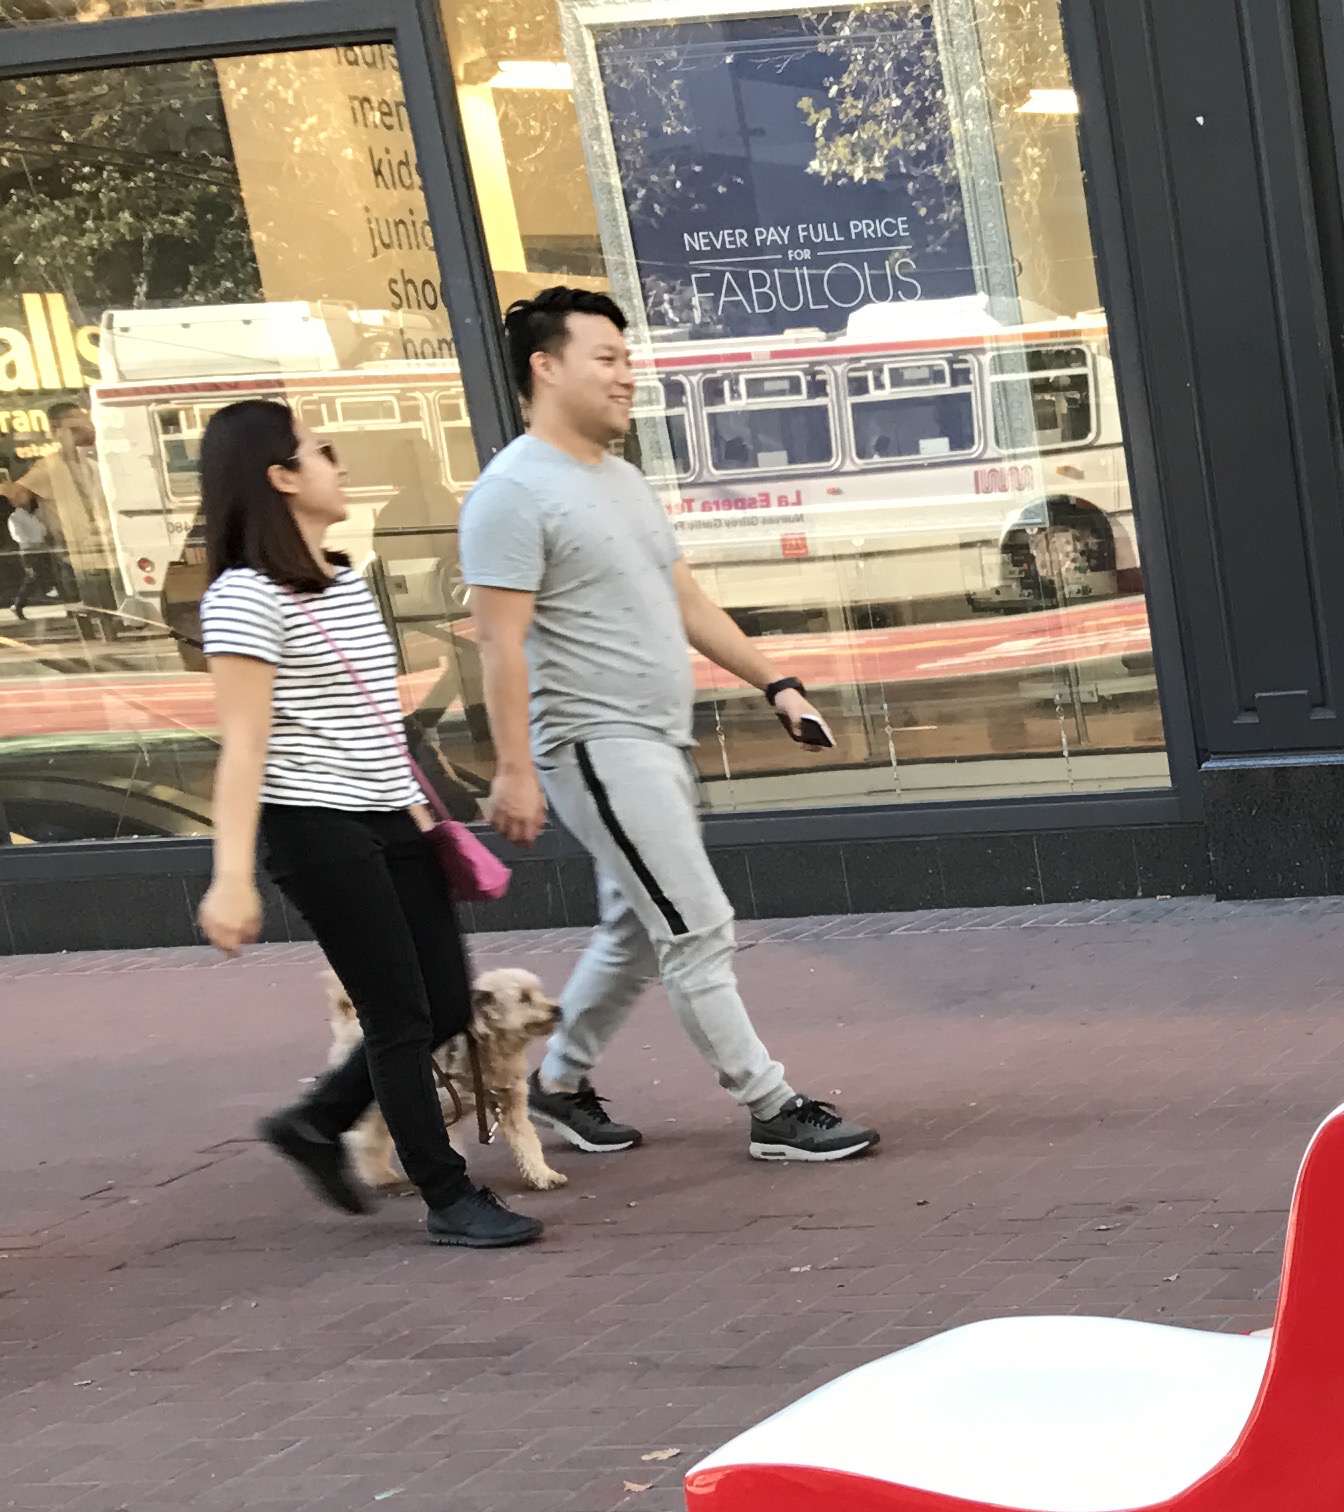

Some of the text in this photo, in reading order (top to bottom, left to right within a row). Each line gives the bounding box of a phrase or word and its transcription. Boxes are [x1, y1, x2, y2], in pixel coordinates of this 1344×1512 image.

[683, 216, 910, 251] NEVER PAY FULL PRICE
[787, 248, 811, 261] FOR
[690, 257, 922, 325] FABULOUS
